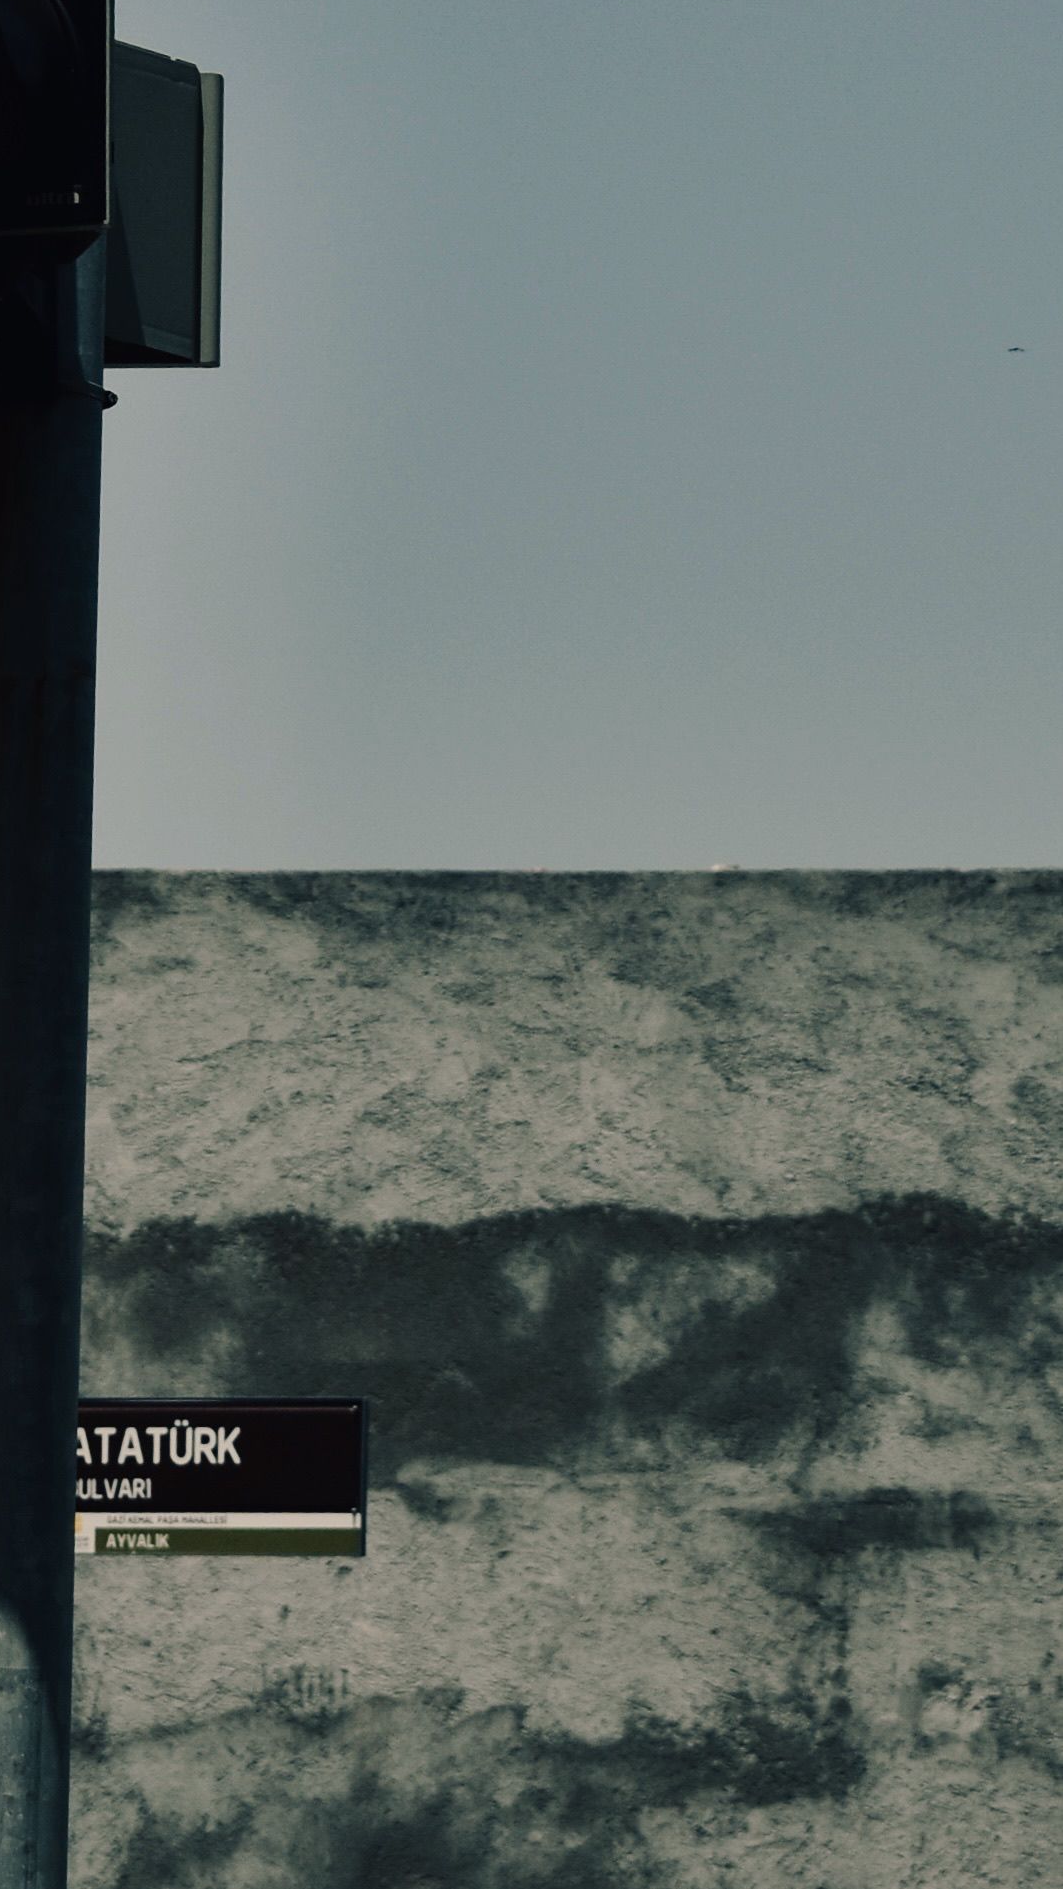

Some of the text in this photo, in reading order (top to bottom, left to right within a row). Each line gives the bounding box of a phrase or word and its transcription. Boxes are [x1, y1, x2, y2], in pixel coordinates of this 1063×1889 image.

[76, 1419, 241, 1465] ATATÜRK
[76, 1478, 152, 1500] ULVARI
[106, 1533, 169, 1548] AYVALIK
